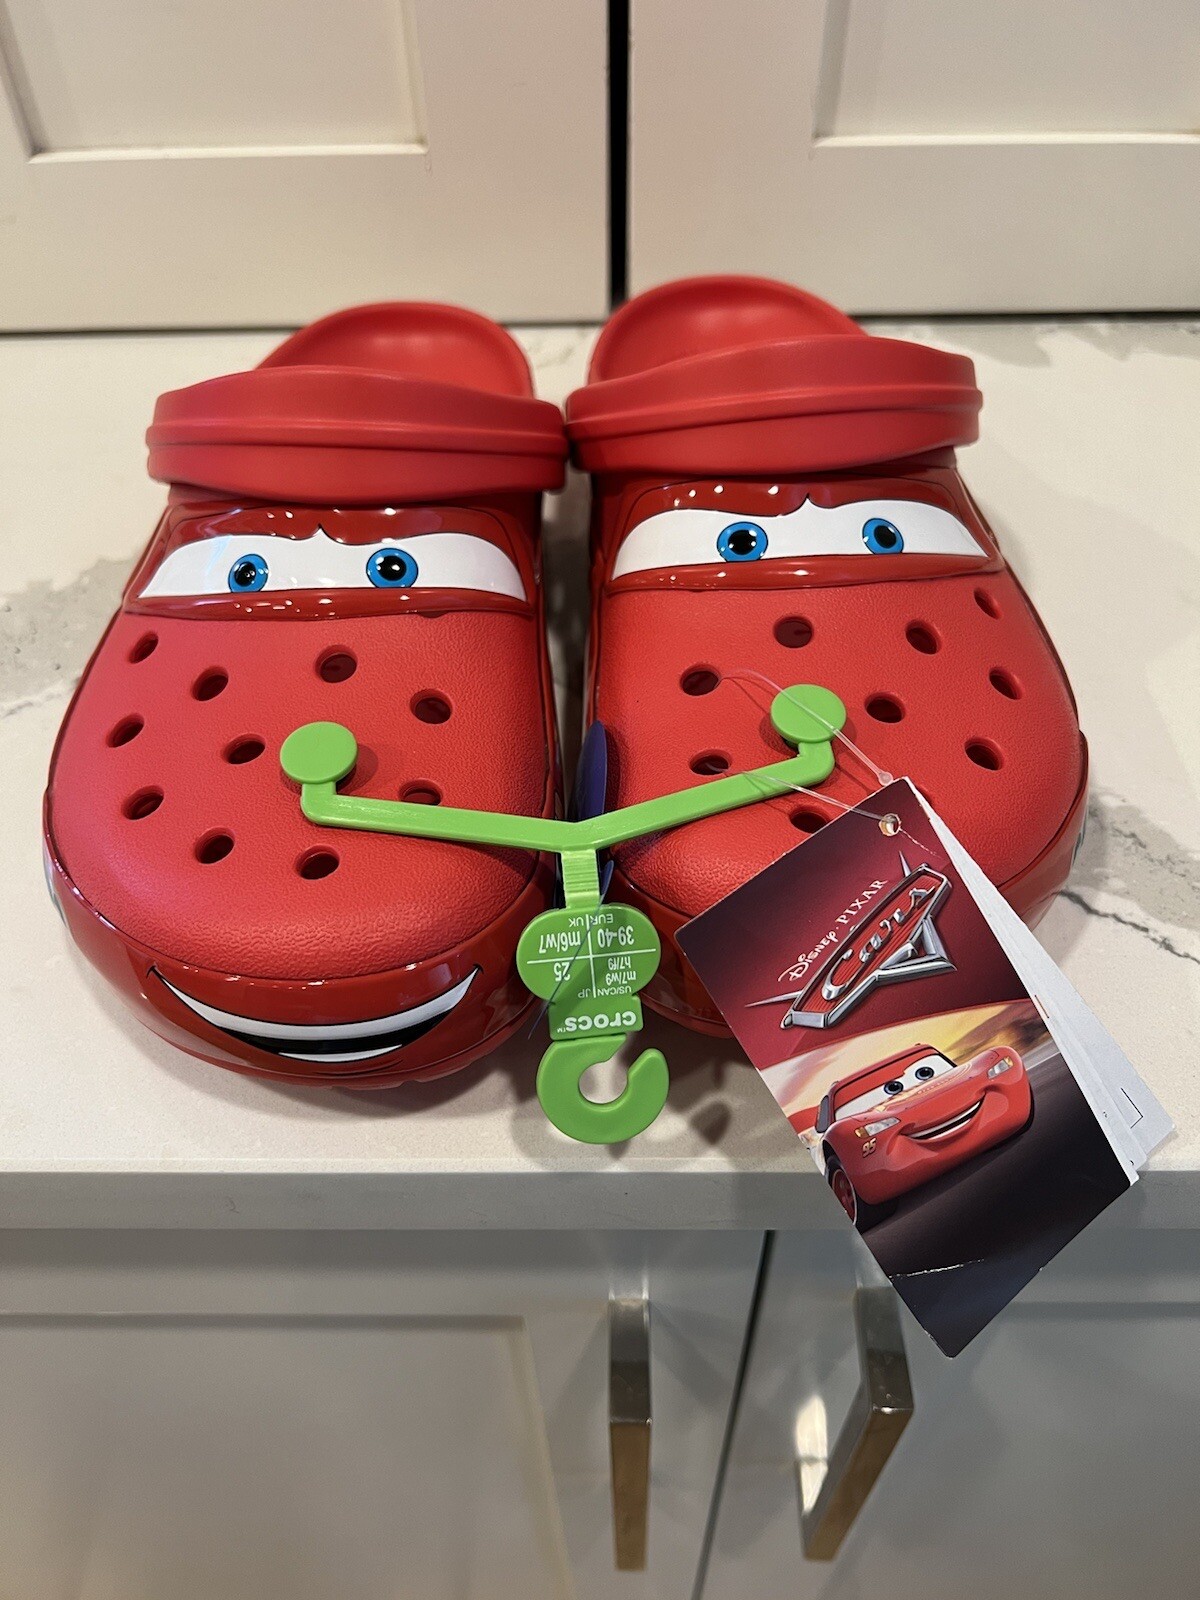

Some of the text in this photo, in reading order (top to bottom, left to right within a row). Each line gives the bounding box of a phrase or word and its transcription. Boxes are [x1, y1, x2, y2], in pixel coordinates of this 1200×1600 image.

[834, 879, 890, 925] PIXAR
[568, 916, 584, 928] UK
[590, 913, 614, 926] EUR
[538, 930, 581, 954] m6/w7
[597, 925, 635, 948] 39-40
[822, 885, 935, 1001] Cars
[553, 962, 571, 982] 25
[608, 956, 632, 970] h7/f9
[605, 970, 637, 986] m7/w9
[578, 988, 591, 999] JP
[597, 985, 632, 996] US/CAN
[862, 1137, 877, 1158] 95
